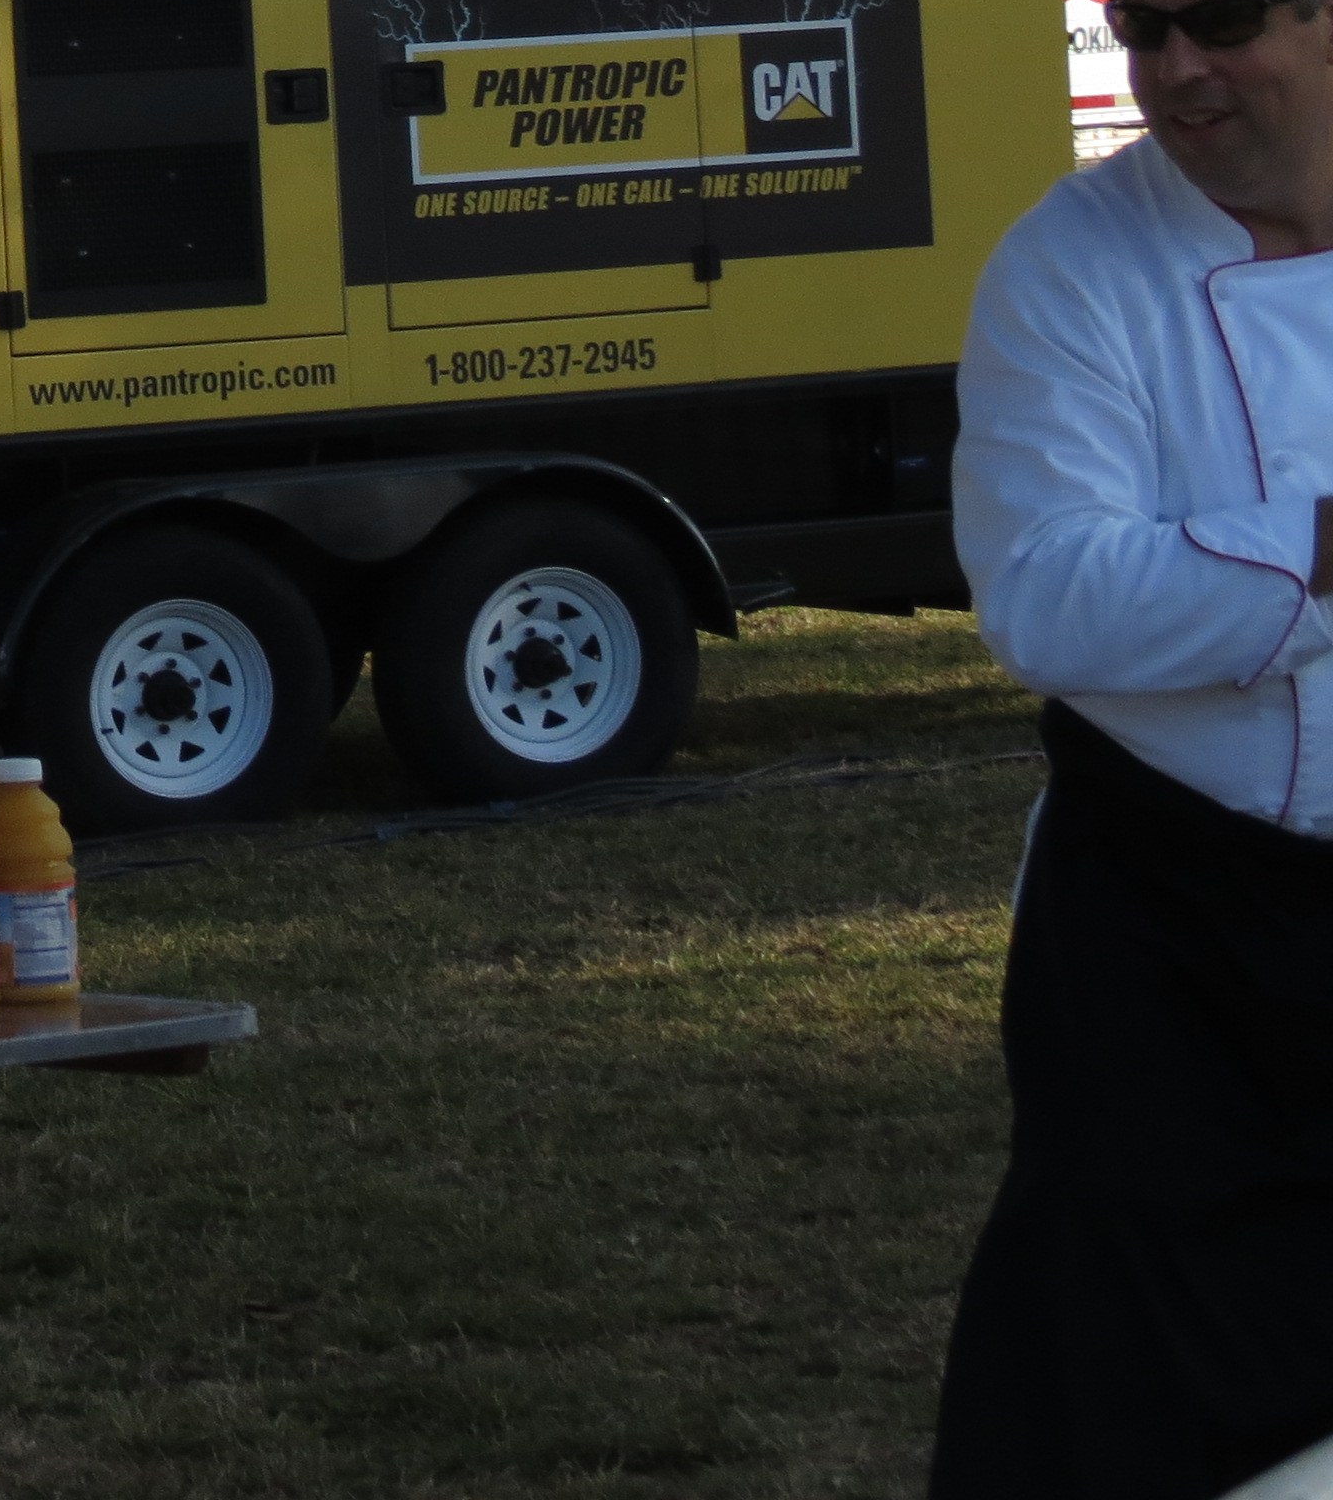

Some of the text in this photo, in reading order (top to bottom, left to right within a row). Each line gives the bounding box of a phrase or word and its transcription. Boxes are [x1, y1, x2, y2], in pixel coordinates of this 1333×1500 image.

[473, 57, 688, 107] PANTROPIC
[509, 103, 647, 148] POWER
[414, 193, 457, 219] ONE
[461, 186, 550, 216] SOURCE
[575, 183, 620, 208] ONE
[622, 178, 674, 205] CALL
[700, 172, 740, 199] ONE
[28, 360, 337, 405] www.pantropic.com
[424, 337, 658, 387] 1-800-237-2945
